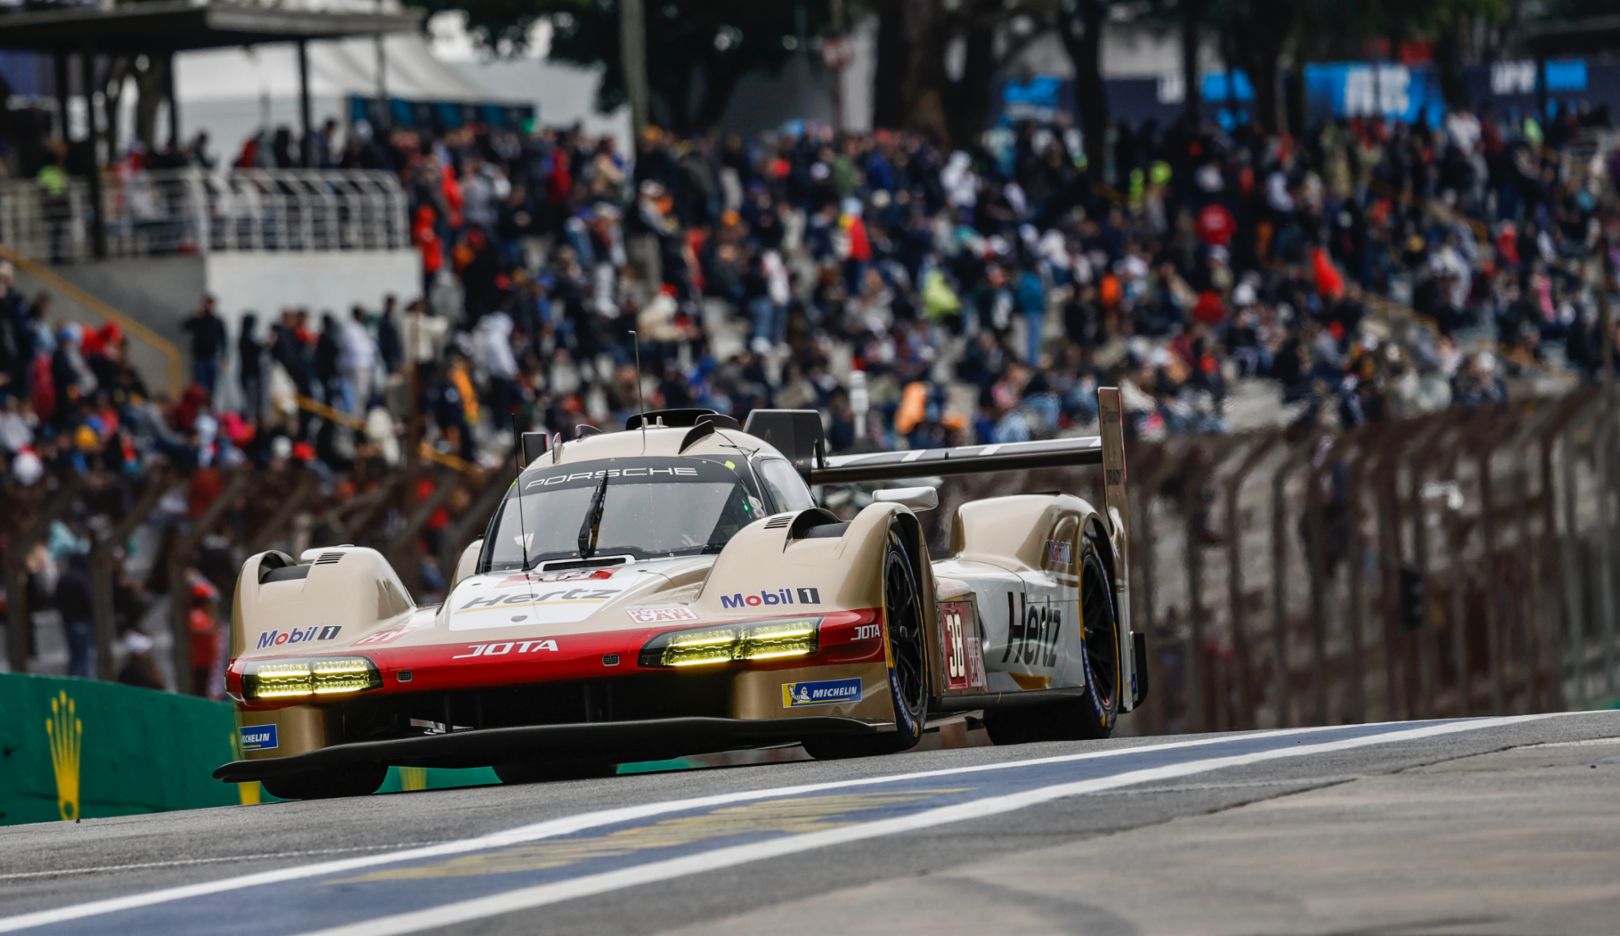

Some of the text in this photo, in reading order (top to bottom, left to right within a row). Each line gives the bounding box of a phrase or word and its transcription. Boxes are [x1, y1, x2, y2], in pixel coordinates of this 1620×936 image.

[526, 467, 698, 490] PORSCHE
[460, 588, 622, 609] Hertz
[720, 588, 816, 609] Mobil 1
[257, 626, 319, 650] Mobil
[850, 624, 881, 641] JOTA
[1002, 591, 1061, 667] Hertz
[452, 639, 559, 660] JOTA
[945, 613, 966, 678] 38
[812, 685, 857, 698] MICHELIN
